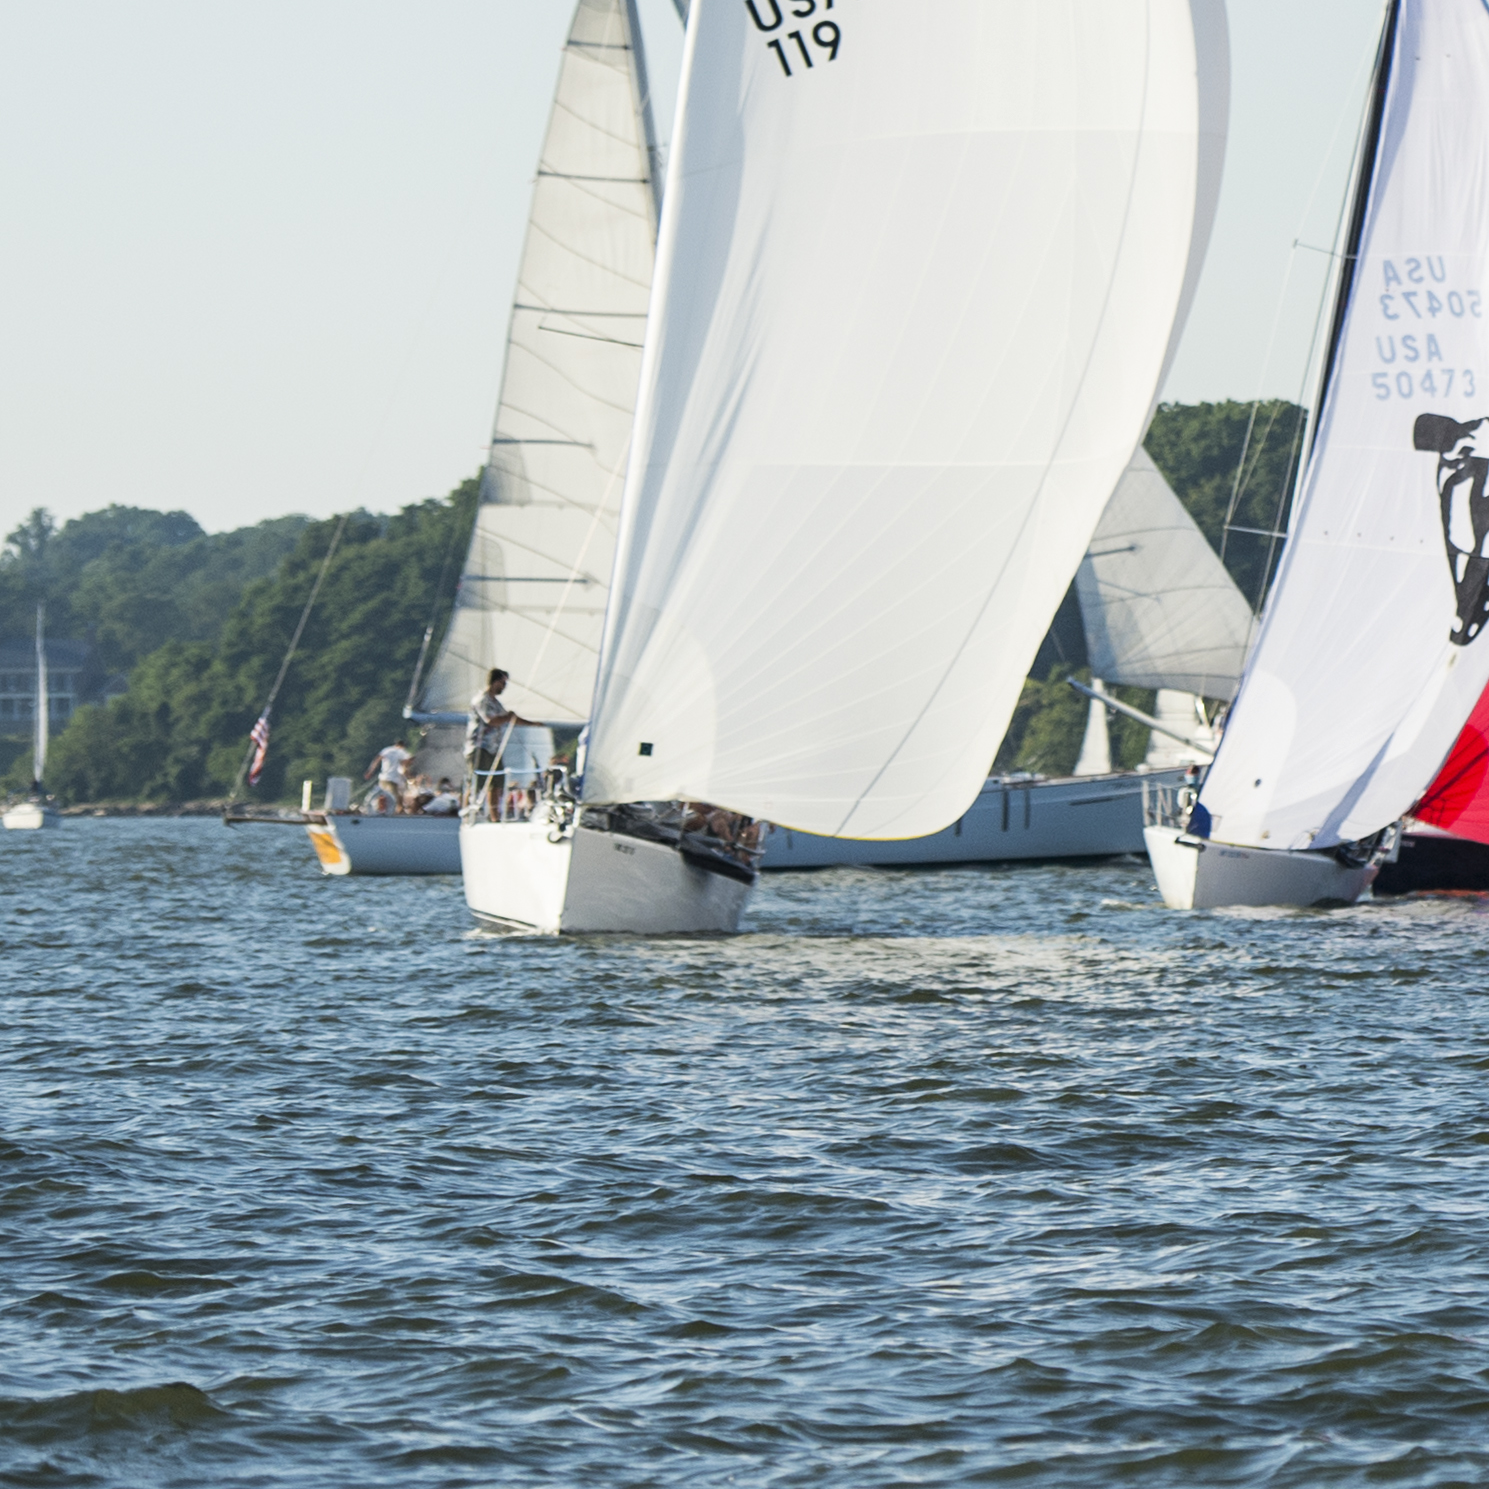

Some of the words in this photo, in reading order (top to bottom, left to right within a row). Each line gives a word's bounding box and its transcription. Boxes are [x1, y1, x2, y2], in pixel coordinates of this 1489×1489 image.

[767, 20, 841, 77] 119
[1375, 332, 1443, 364] USA
[1371, 369, 1476, 400] 50473
